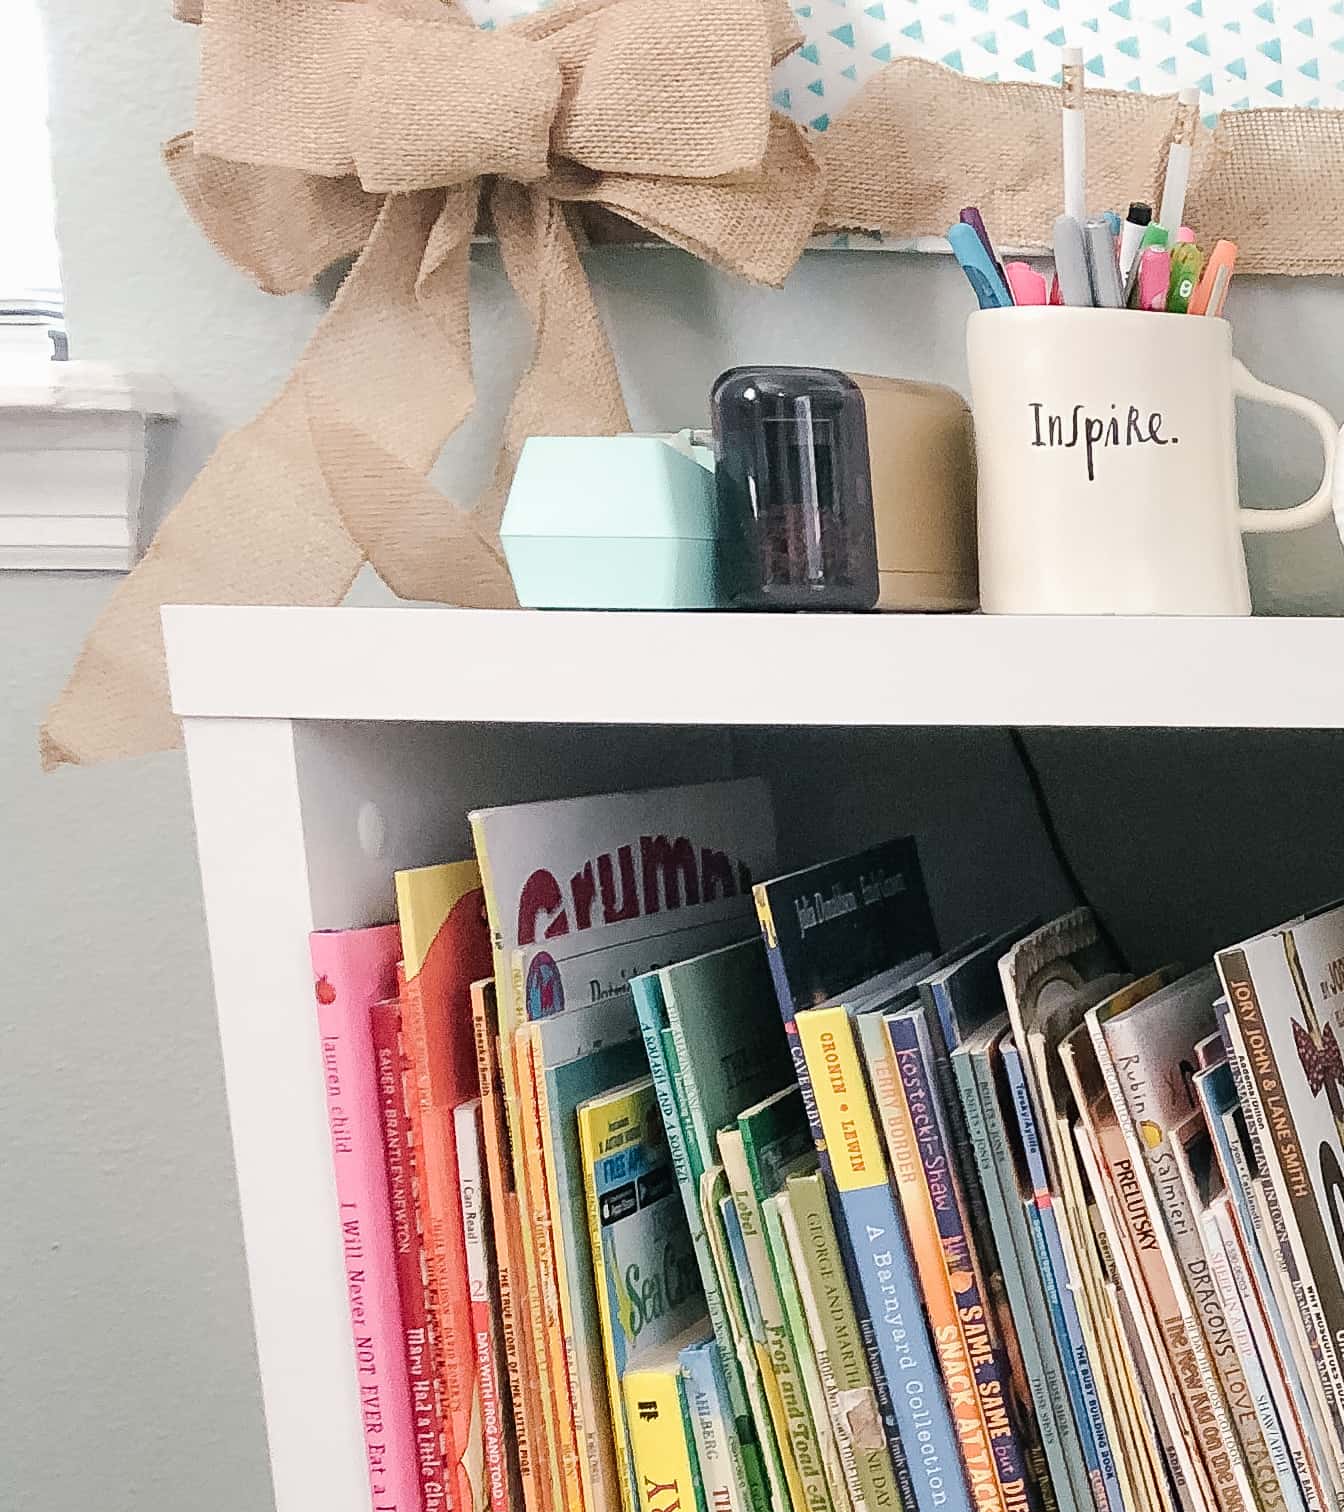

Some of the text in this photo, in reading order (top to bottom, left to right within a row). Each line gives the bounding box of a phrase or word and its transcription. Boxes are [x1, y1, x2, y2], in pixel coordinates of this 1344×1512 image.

[1231, 980, 1259, 1022] JORY
[321, 1036, 340, 1097] lauren
[1244, 1029, 1272, 1075] JOHN
[1262, 1079, 1278, 1091] &
[330, 1106, 351, 1154] child
[1263, 1096, 1293, 1139] LANE
[1118, 1055, 1191, 1237] Rubin Salmieri
[1278, 1144, 1309, 1198] SMITH
[341, 1202, 359, 1210] I
[462, 1187, 475, 1208] Can
[1113, 1160, 1158, 1250] PRELUTSKY
[342, 1220, 362, 1260] Will
[820, 1032, 949, 1506] CRONIN LEWIN A Barnyard Collection
[346, 1269, 369, 1326] Never
[356, 1337, 374, 1377] NOT
[935, 1326, 970, 1406] SNACK
[362, 1386, 381, 1433] EVER
[413, 1380, 430, 1414] Had
[417, 1419, 429, 1427] a
[978, 1382, 1005, 1438] SAME
[992, 1444, 1016, 1477] but
[369, 1445, 385, 1473] Eat
[418, 1432, 434, 1477] Little
[374, 1485, 384, 1494] a
